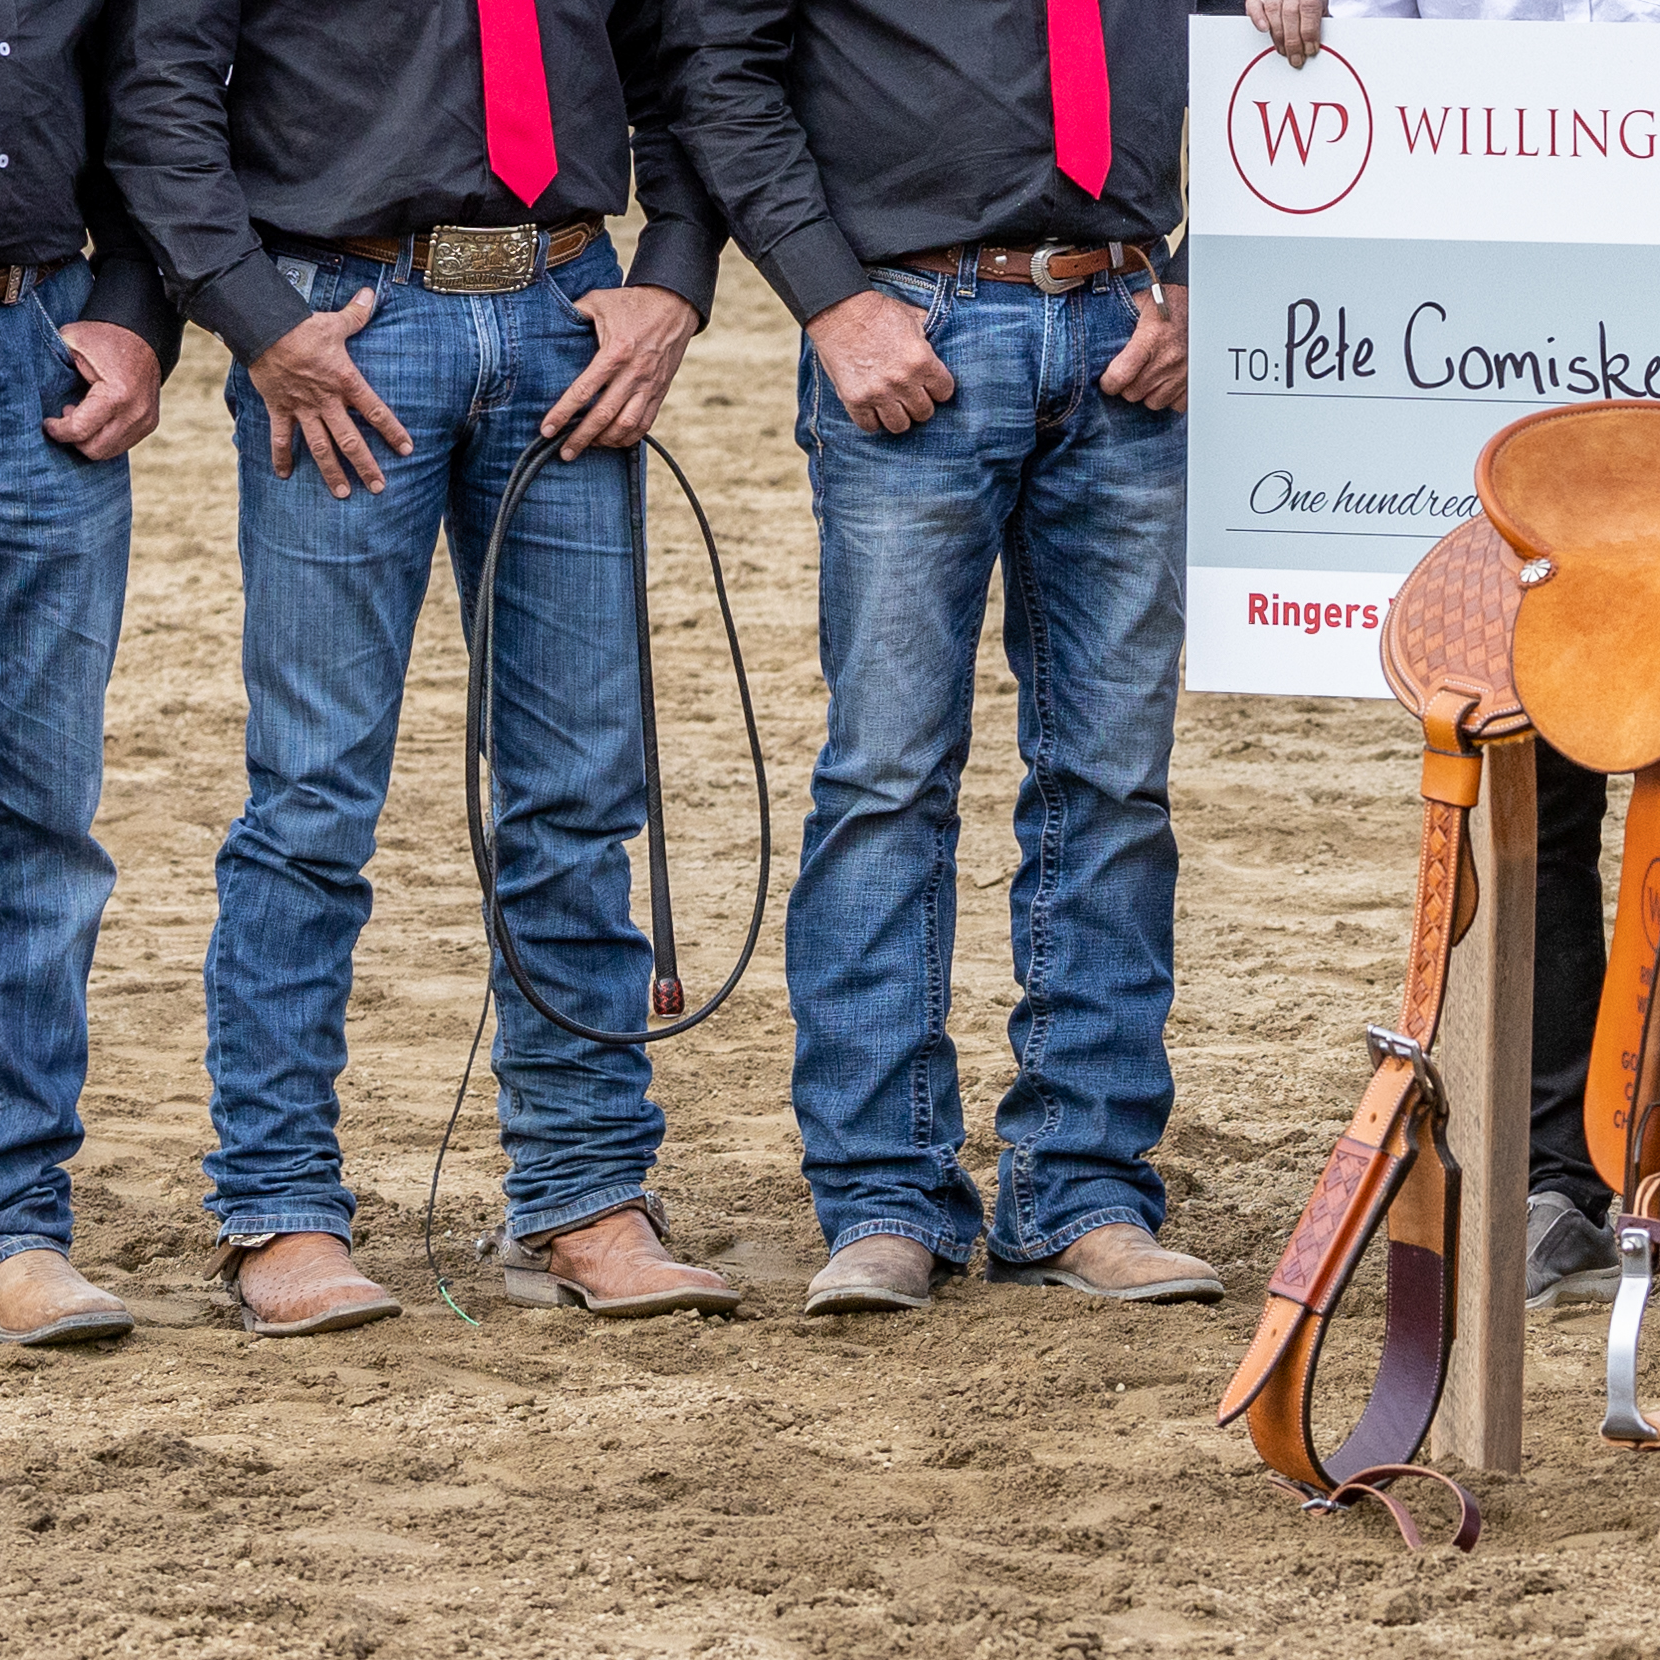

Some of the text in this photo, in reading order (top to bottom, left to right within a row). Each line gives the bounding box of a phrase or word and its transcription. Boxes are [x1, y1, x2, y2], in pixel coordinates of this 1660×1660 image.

[1228, 347, 1280, 383] TO:
[1285, 297, 1376, 389] Pete
[1249, 470, 1328, 515] One
[1248, 592, 1379, 635] Ringers
